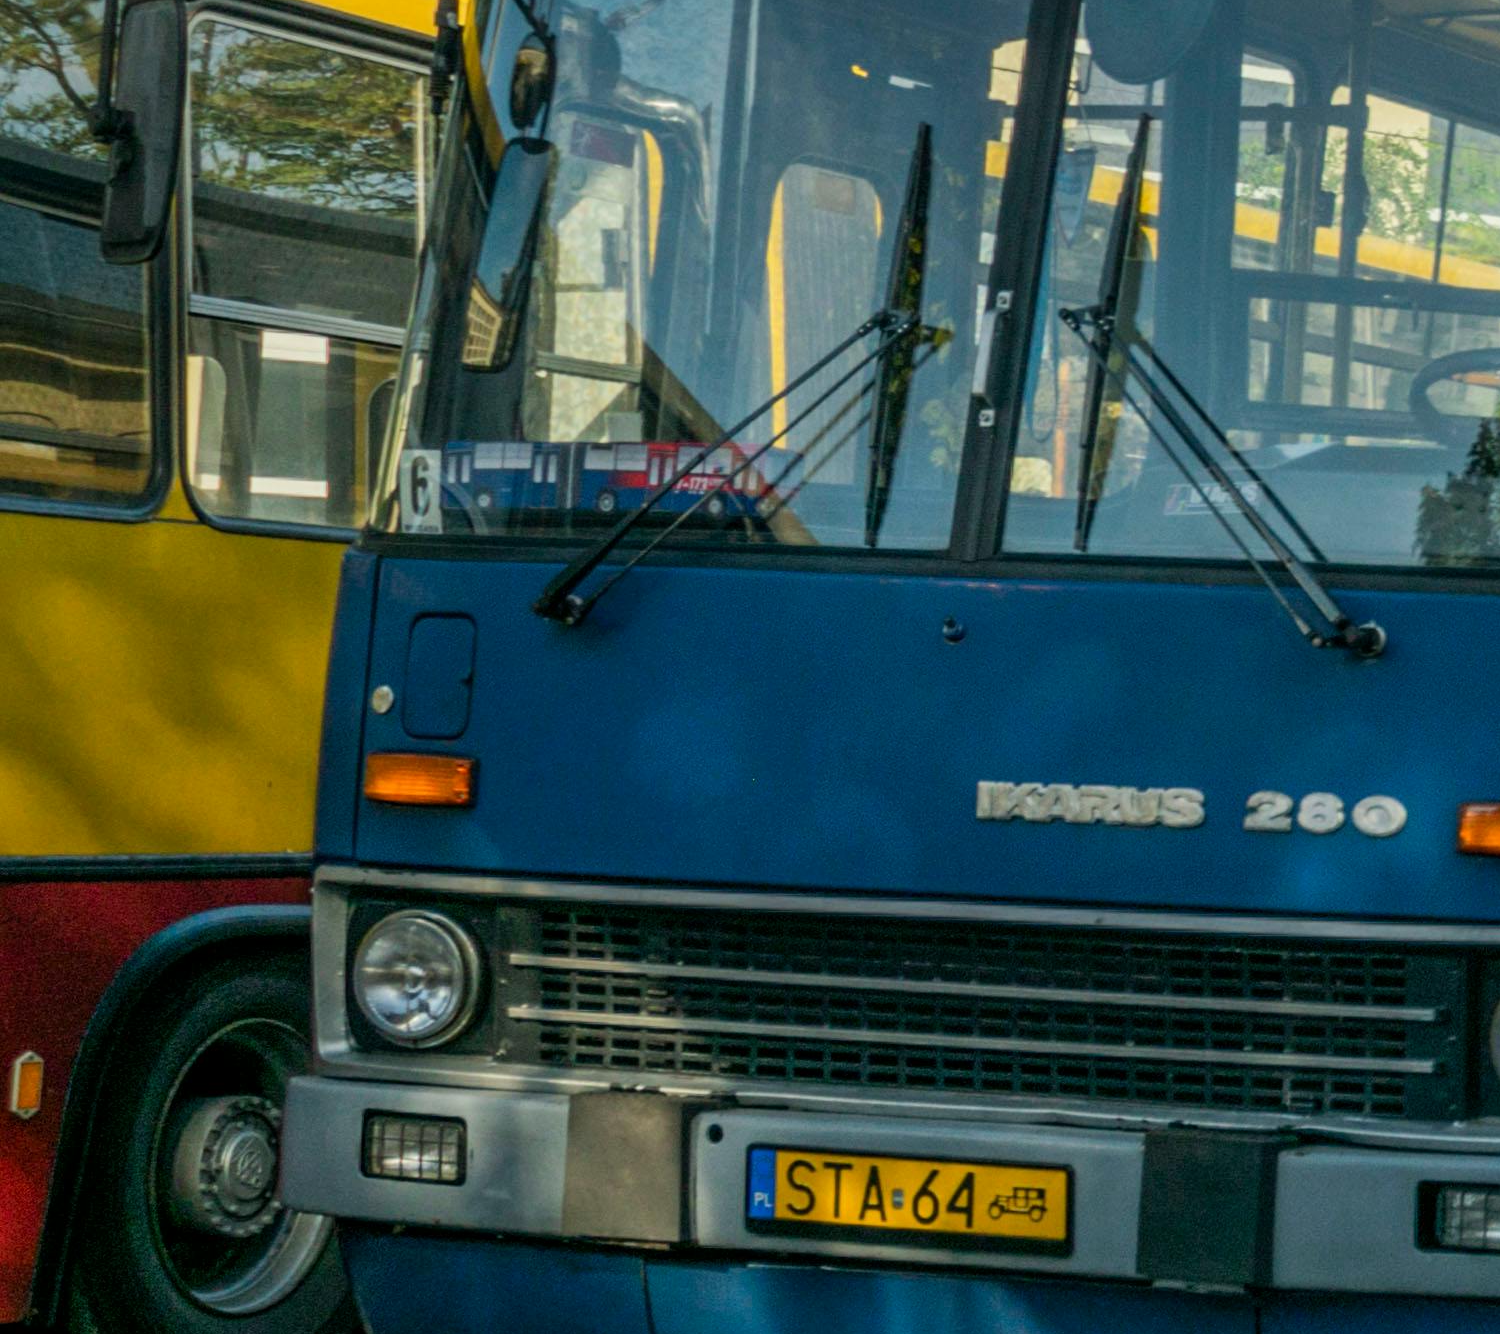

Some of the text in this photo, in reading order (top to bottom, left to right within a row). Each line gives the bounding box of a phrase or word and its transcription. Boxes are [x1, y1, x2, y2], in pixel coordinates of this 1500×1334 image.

[410, 454, 431, 517] 6
[976, 780, 1408, 838] IKARUS 280
[753, 1192, 772, 1208] PL
[785, 1159, 976, 1229] STA 64
